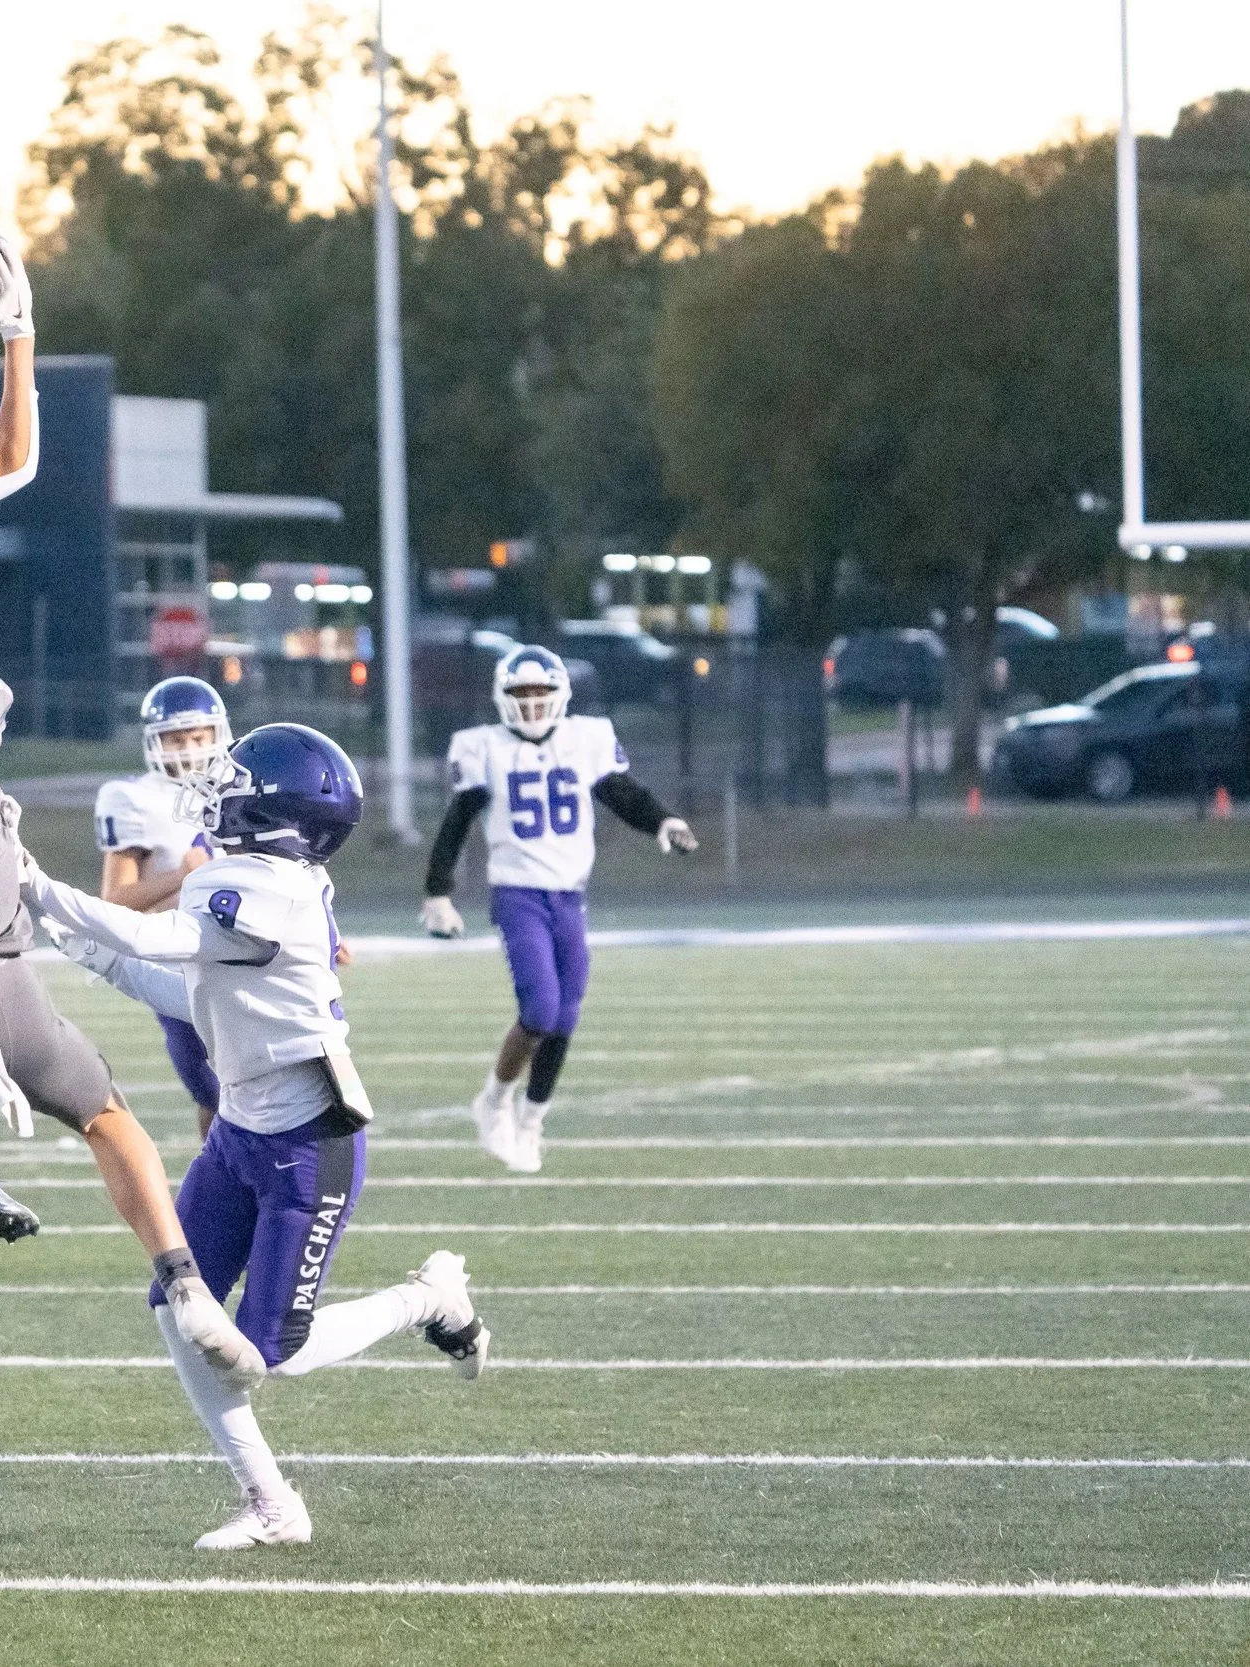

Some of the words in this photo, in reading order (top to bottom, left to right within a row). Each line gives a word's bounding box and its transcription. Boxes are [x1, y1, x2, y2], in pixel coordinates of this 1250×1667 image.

[506, 767, 580, 840] 56
[207, 889, 243, 929] 9
[292, 1192, 346, 1311] PASCHAL
